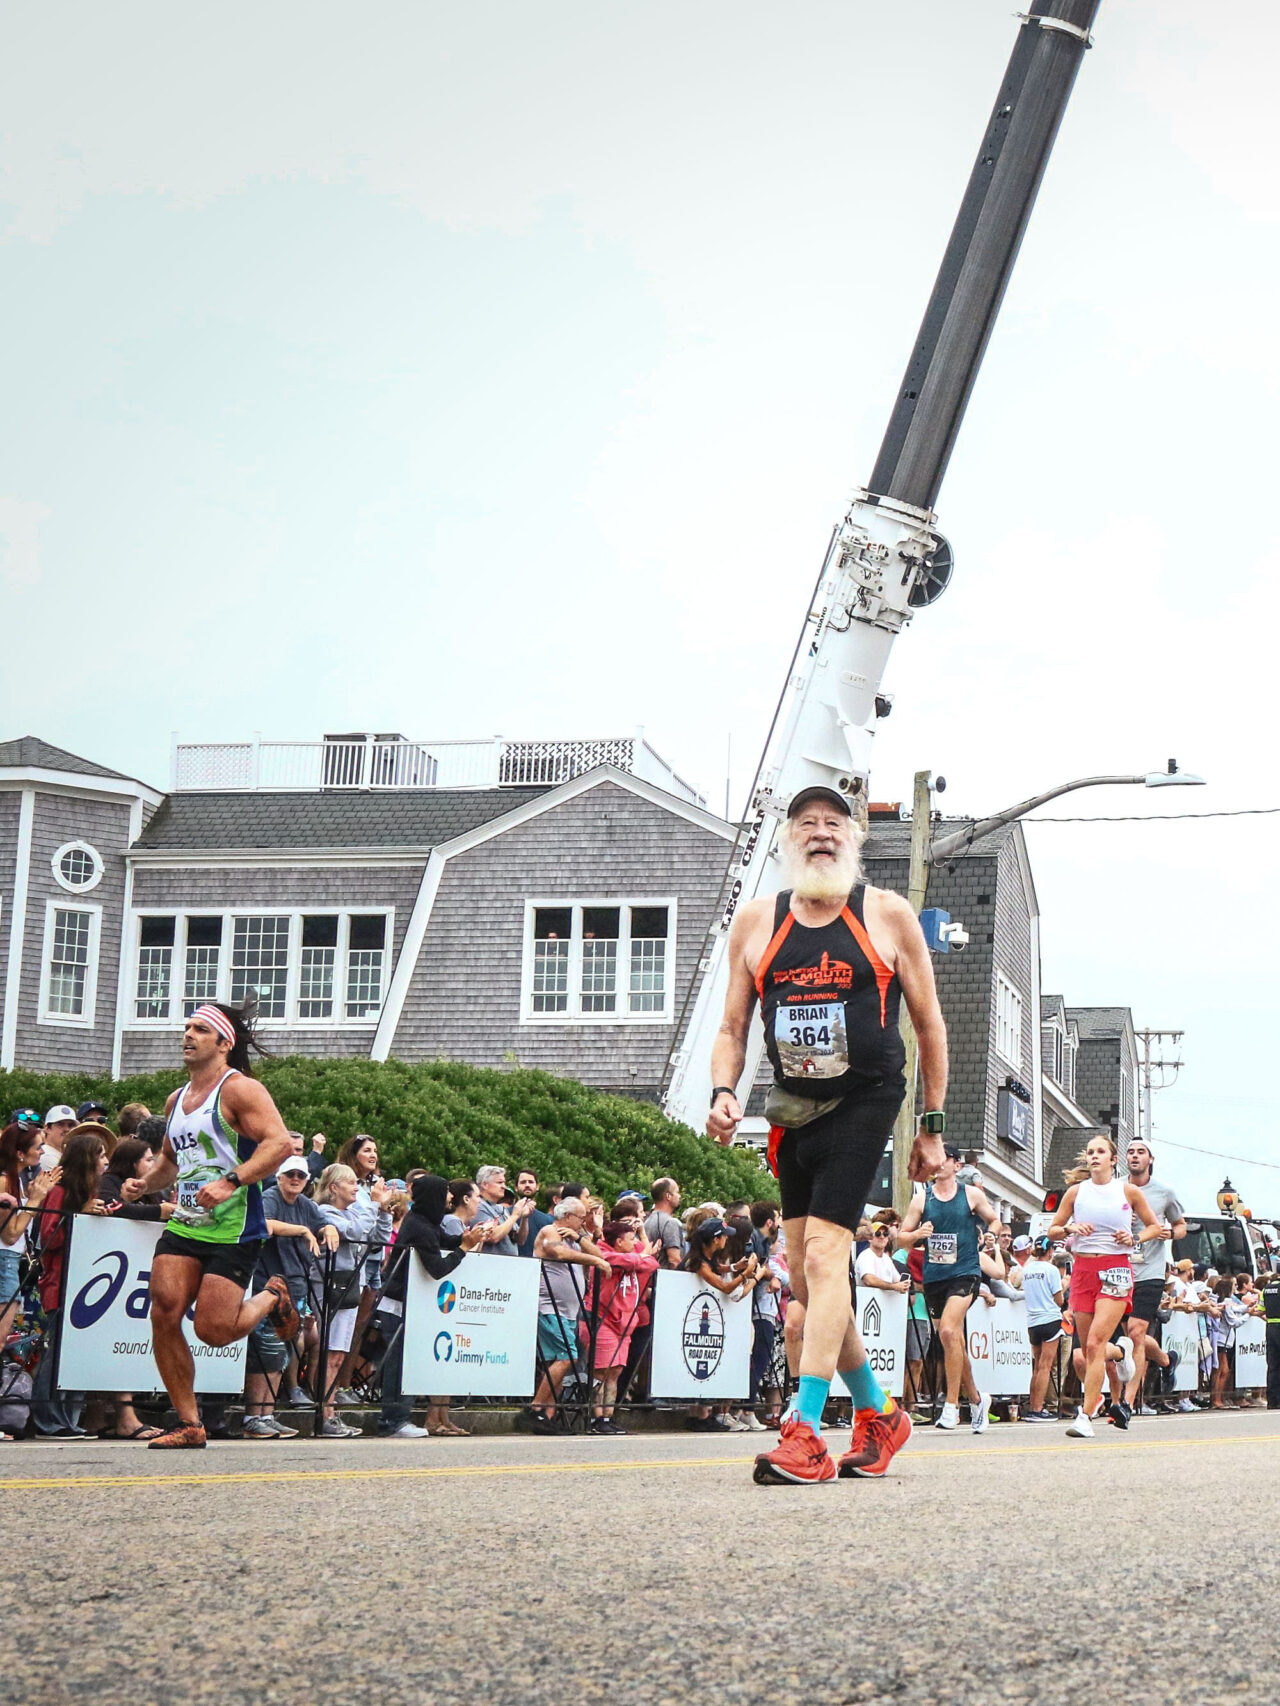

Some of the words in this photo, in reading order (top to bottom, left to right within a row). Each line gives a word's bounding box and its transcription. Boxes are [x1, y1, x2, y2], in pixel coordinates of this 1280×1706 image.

[815, 606, 828, 637] TADANO
[720, 879, 743, 933] LEO
[774, 969, 853, 985] FALMOUTH
[803, 992, 838, 1001] RUNNING
[789, 1007, 829, 1021] BRIAN
[789, 1025, 831, 1047] 364
[184, 1182, 199, 1191] NICK
[931, 1241, 953, 1251] 7262
[460, 1286, 512, 1302] Dana-Farber
[458, 1302, 480, 1312] Cancer
[481, 1303, 505, 1315] Institute
[455, 1334, 471, 1348] The
[684, 1334, 722, 1347] FALMOUTH
[995, 1330, 1023, 1345] CAPITAL
[113, 1339, 151, 1355] sound
[216, 1343, 243, 1361] body
[969, 1331, 989, 1360] G2
[1238, 1344, 1248, 1356] The
[455, 1350, 484, 1367] Jimmy
[688, 1349, 703, 1360] ROAD
[704, 1349, 718, 1360] RACE
[996, 1351, 1031, 1366] ADVISORS
